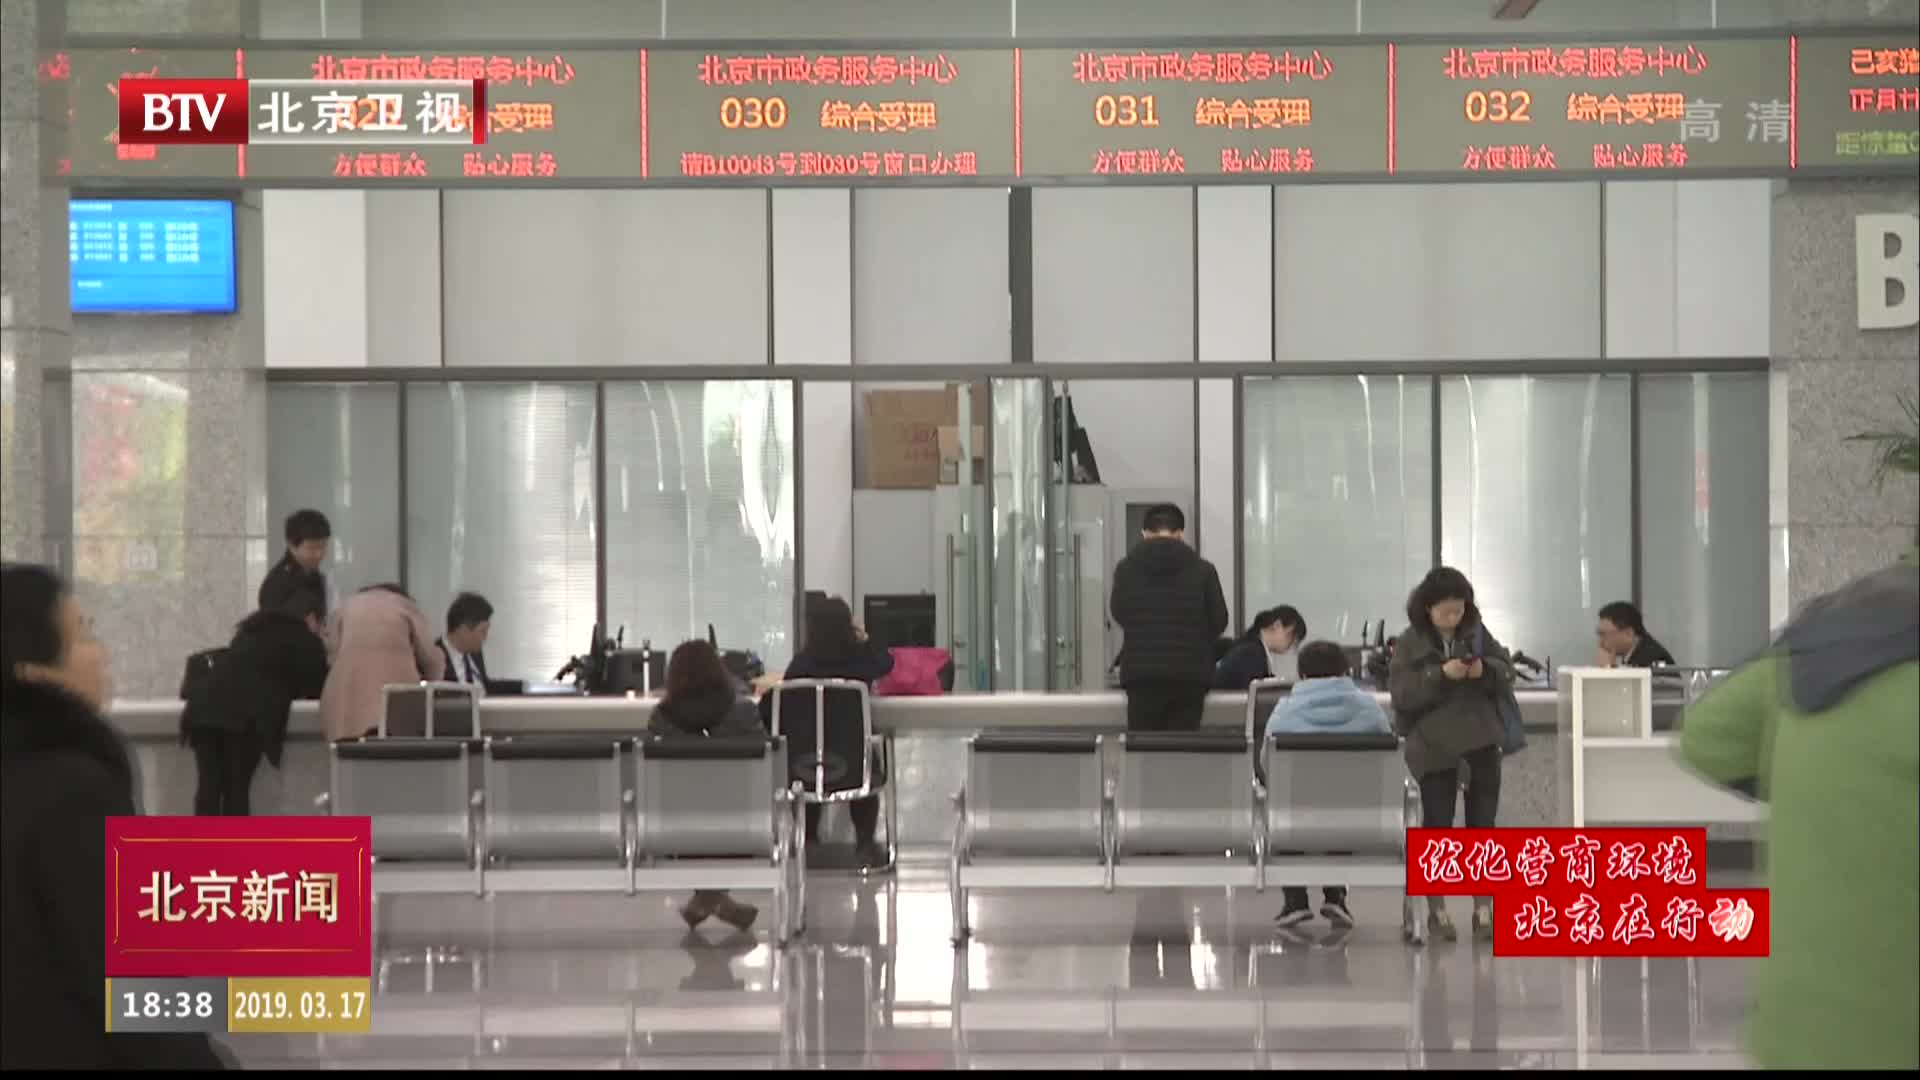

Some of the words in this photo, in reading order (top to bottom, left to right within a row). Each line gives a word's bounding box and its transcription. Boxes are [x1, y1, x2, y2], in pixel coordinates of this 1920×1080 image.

[312, 55, 575, 87] 北京市政务服务中心
[698, 54, 957, 86] 北京市政务服务中心
[1072, 51, 1332, 83] 北京市政务服务中心
[1443, 46, 1707, 79] 北京市政务服务中心
[720, 97, 787, 128] 030
[820, 101, 937, 132] 综合受理
[1095, 95, 1159, 127] 031
[1195, 97, 1311, 129] 综合受理
[1465, 91, 1531, 122] 032
[1567, 92, 1686, 125] 综合受理
[334, 152, 428, 178] 方便群众
[463, 152, 557, 177] 贴心服务
[1093, 147, 1185, 174] 方便群众
[1221, 147, 1314, 172] 贴心服务
[1463, 144, 1557, 170] 方便群众
[1593, 142, 1689, 168] 贴心服务
